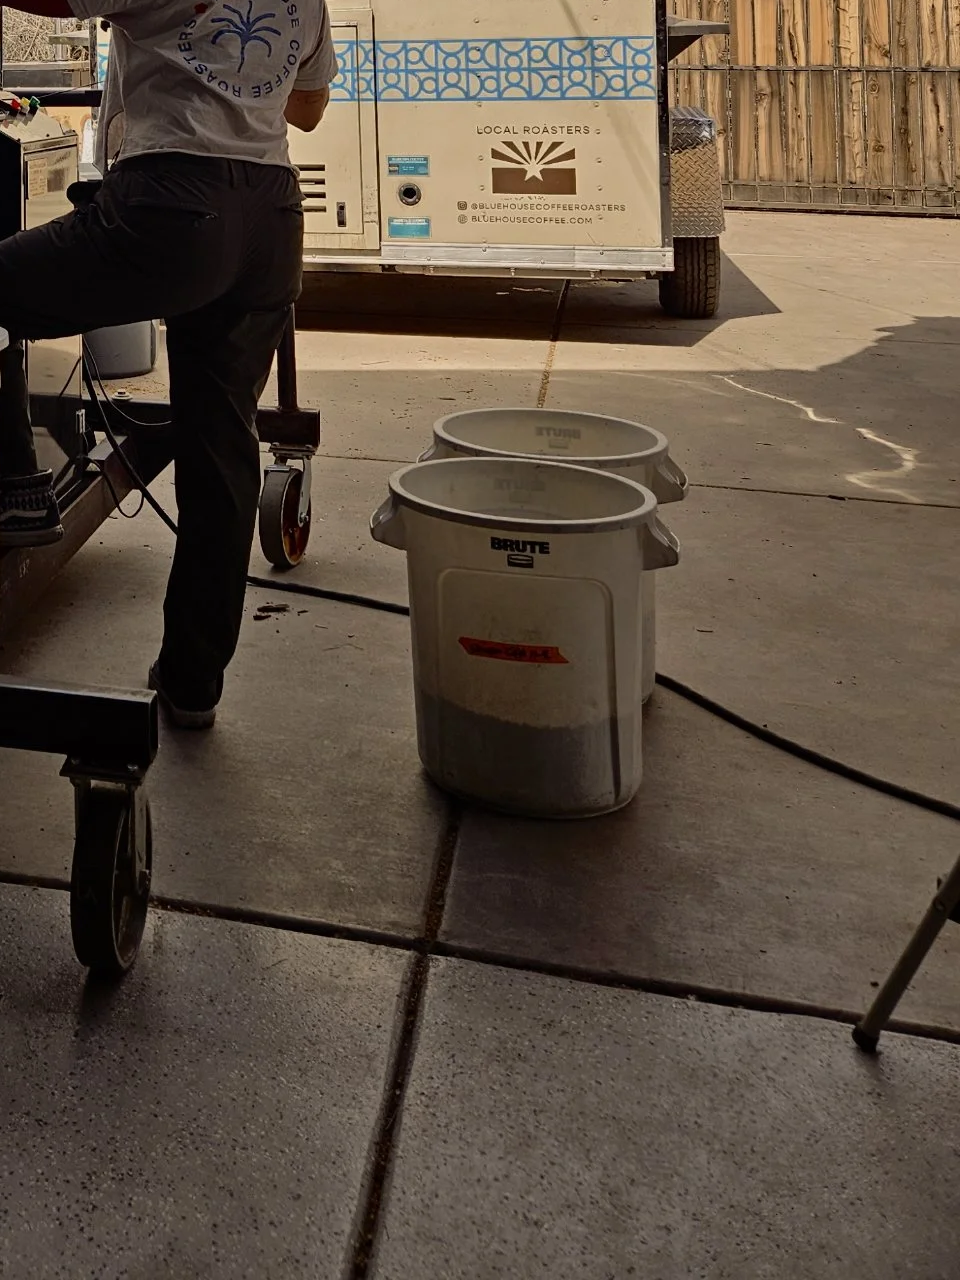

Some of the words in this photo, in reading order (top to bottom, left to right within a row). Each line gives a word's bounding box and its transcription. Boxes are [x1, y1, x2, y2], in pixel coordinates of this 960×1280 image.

[178, 19, 242, 98] ROASTERS
[252, 39, 300, 98] COFFEE
[476, 125, 519, 135] LOCAL
[523, 125, 590, 135] ROASTERS
[471, 202, 626, 212] @BLUEHOUSECOFFEEROASTERS
[471, 215, 593, 225] BLUEHOUSECOFFEE.COM
[490, 536, 550, 554] BRUTE
